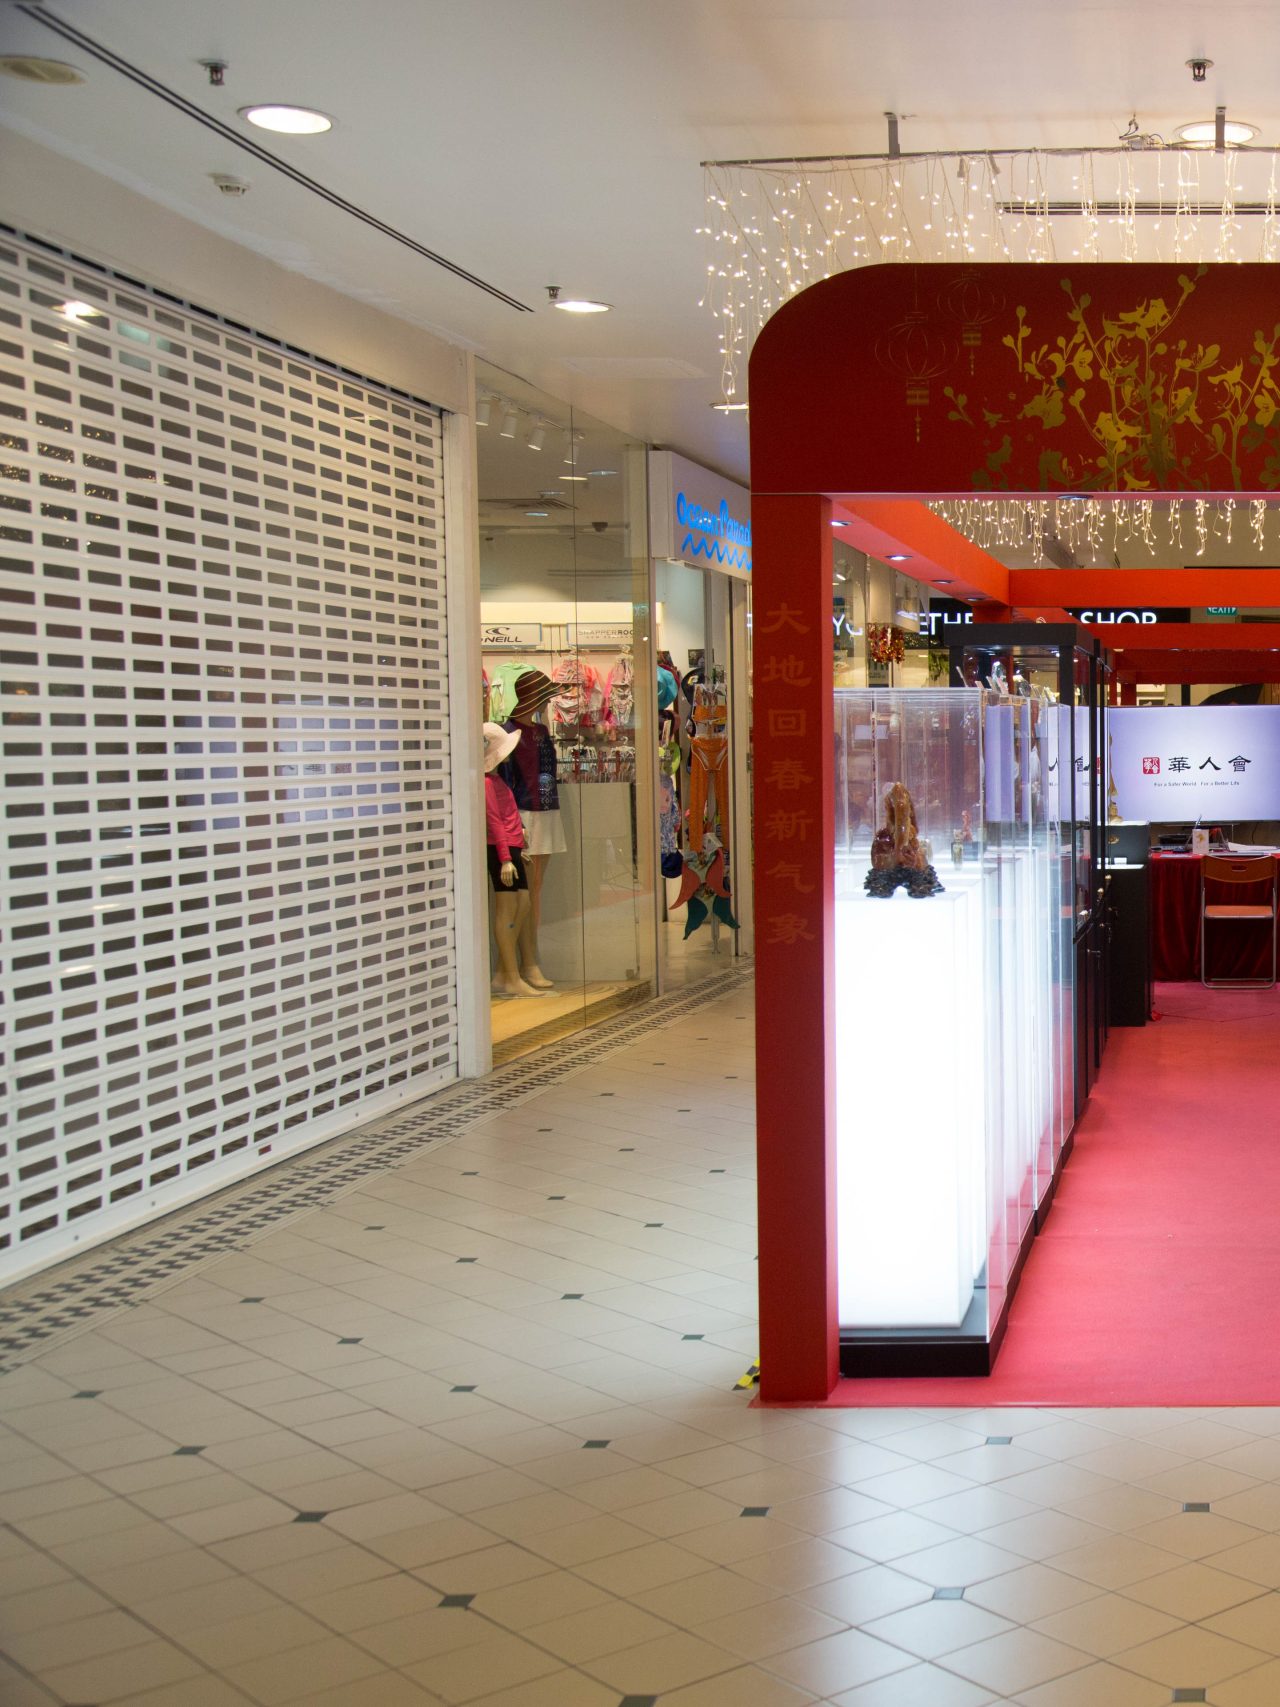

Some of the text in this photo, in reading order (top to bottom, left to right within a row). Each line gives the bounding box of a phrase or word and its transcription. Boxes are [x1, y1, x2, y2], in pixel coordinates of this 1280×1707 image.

[760, 602, 816, 945] 大地回春新气象
[1168, 755, 1252, 773] 華人會
